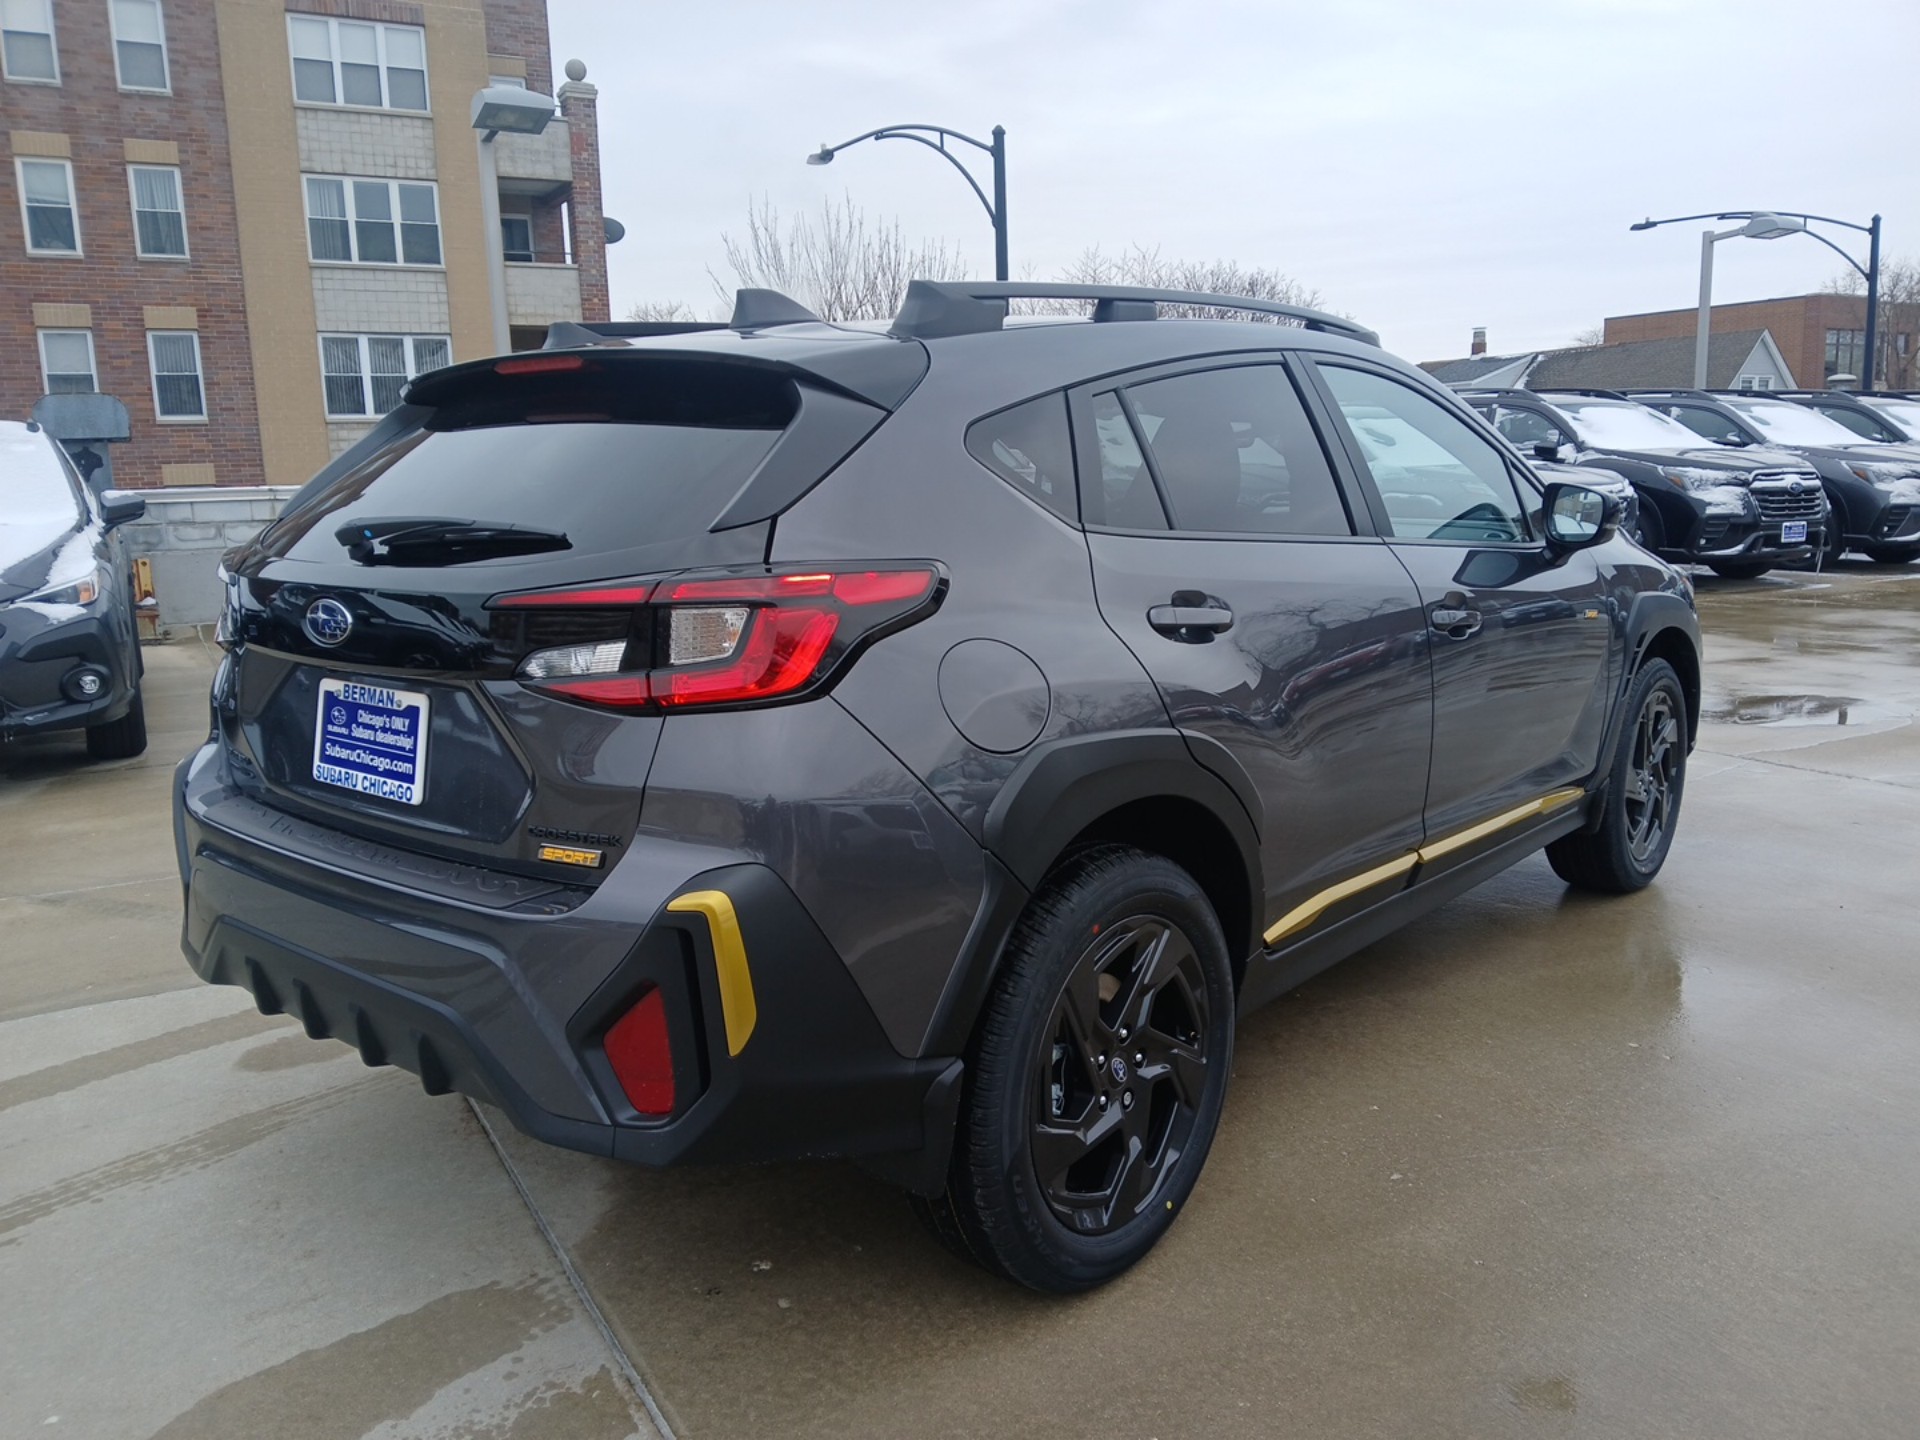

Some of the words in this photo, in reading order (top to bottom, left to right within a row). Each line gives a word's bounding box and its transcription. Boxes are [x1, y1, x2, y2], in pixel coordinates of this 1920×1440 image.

[343, 684, 395, 708] BERMAN
[357, 709, 390, 729] Chicago's
[391, 716, 410, 732] ONLY
[351, 724, 375, 741] Subaru
[376, 729, 414, 751] dealership!
[325, 743, 413, 775] SubaruChicago.com
[315, 764, 358, 789] SUBARU
[361, 776, 413, 802] CHICAGO
[528, 825, 623, 847] CROSSTREK
[543, 847, 596, 865] SPORT
